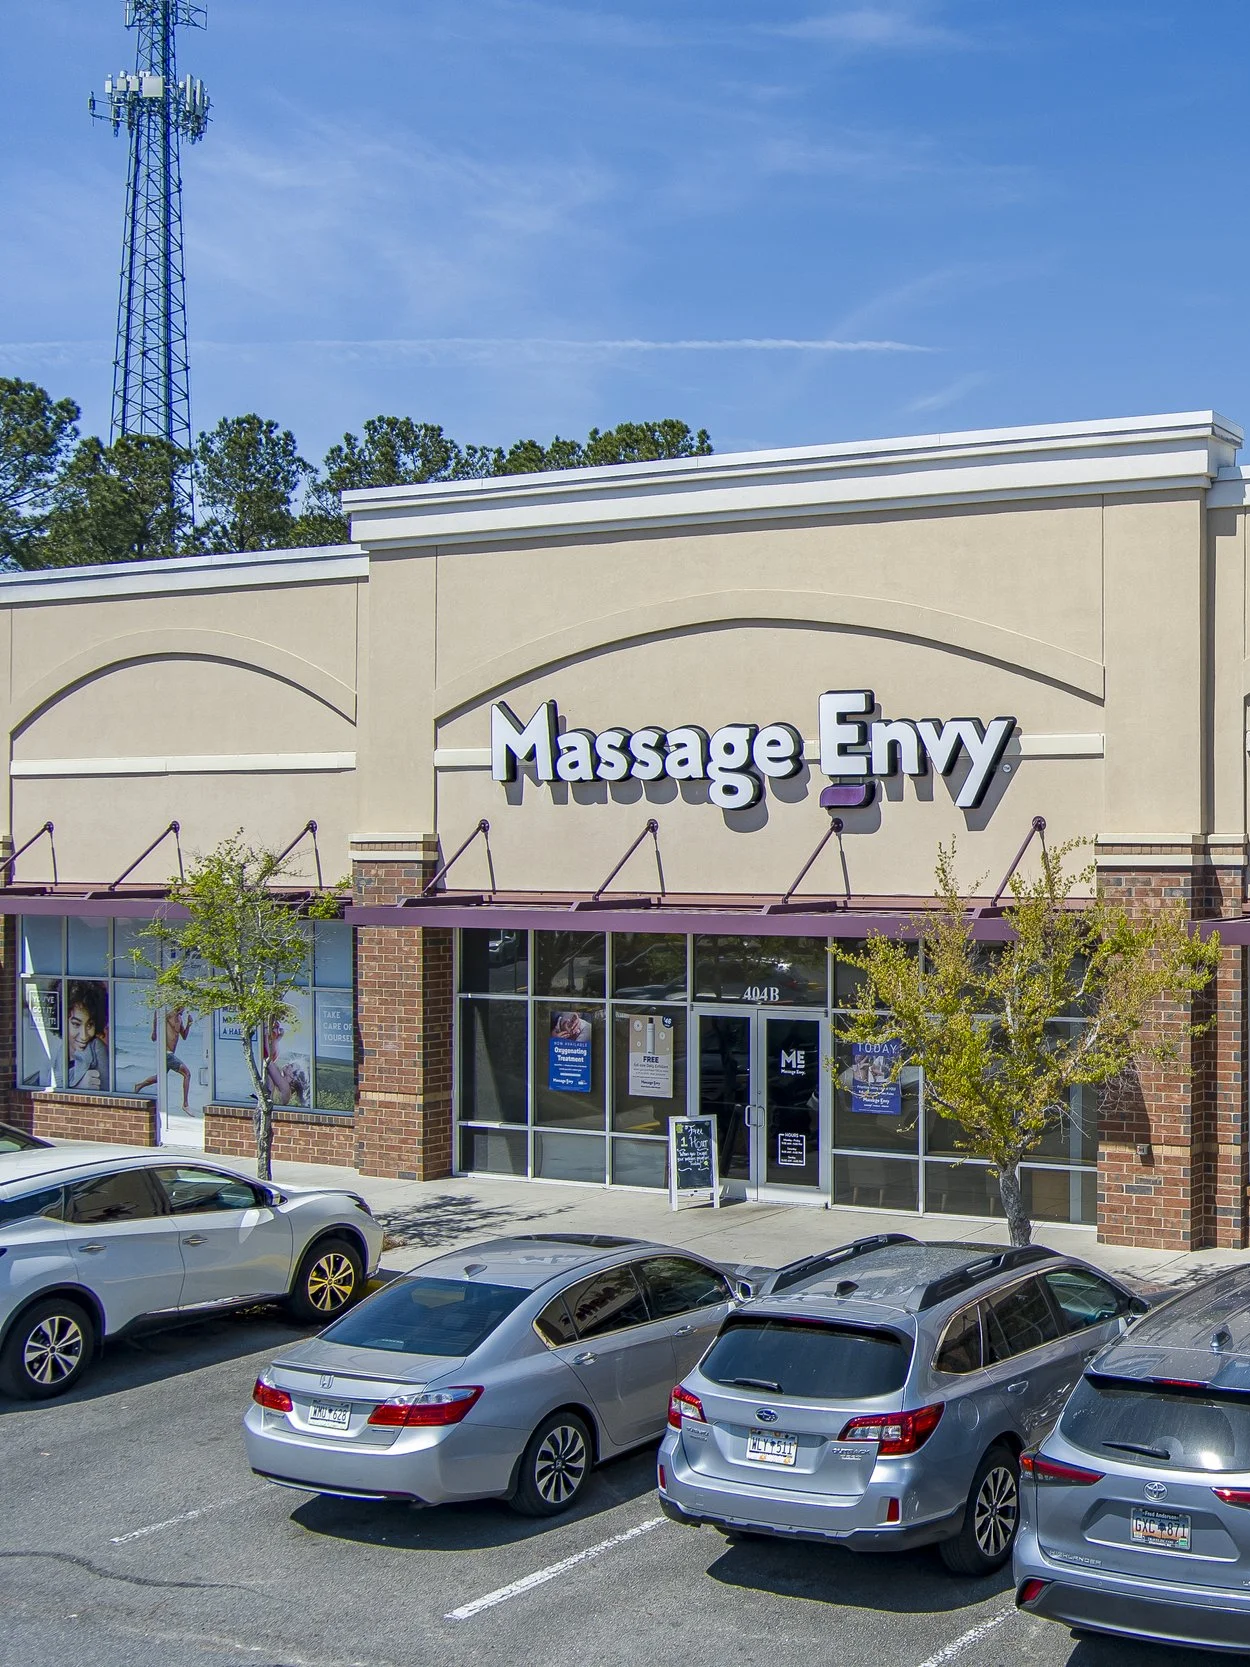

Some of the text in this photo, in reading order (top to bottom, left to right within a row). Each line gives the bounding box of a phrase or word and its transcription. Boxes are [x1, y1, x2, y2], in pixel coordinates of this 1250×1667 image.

[490, 690, 1017, 811] Massage Envy
[742, 986, 781, 1002] 404B
[323, 1011, 341, 1019] TAKE
[323, 1022, 342, 1031] CARE
[857, 1038, 898, 1054] TODAY
[643, 1055, 660, 1064] FREE
[780, 1048, 805, 1069] ME
[332, 1407, 348, 1422] 628
[751, 1436, 793, 1455] WLY 511
[1135, 1517, 1187, 1539] GXC 871
